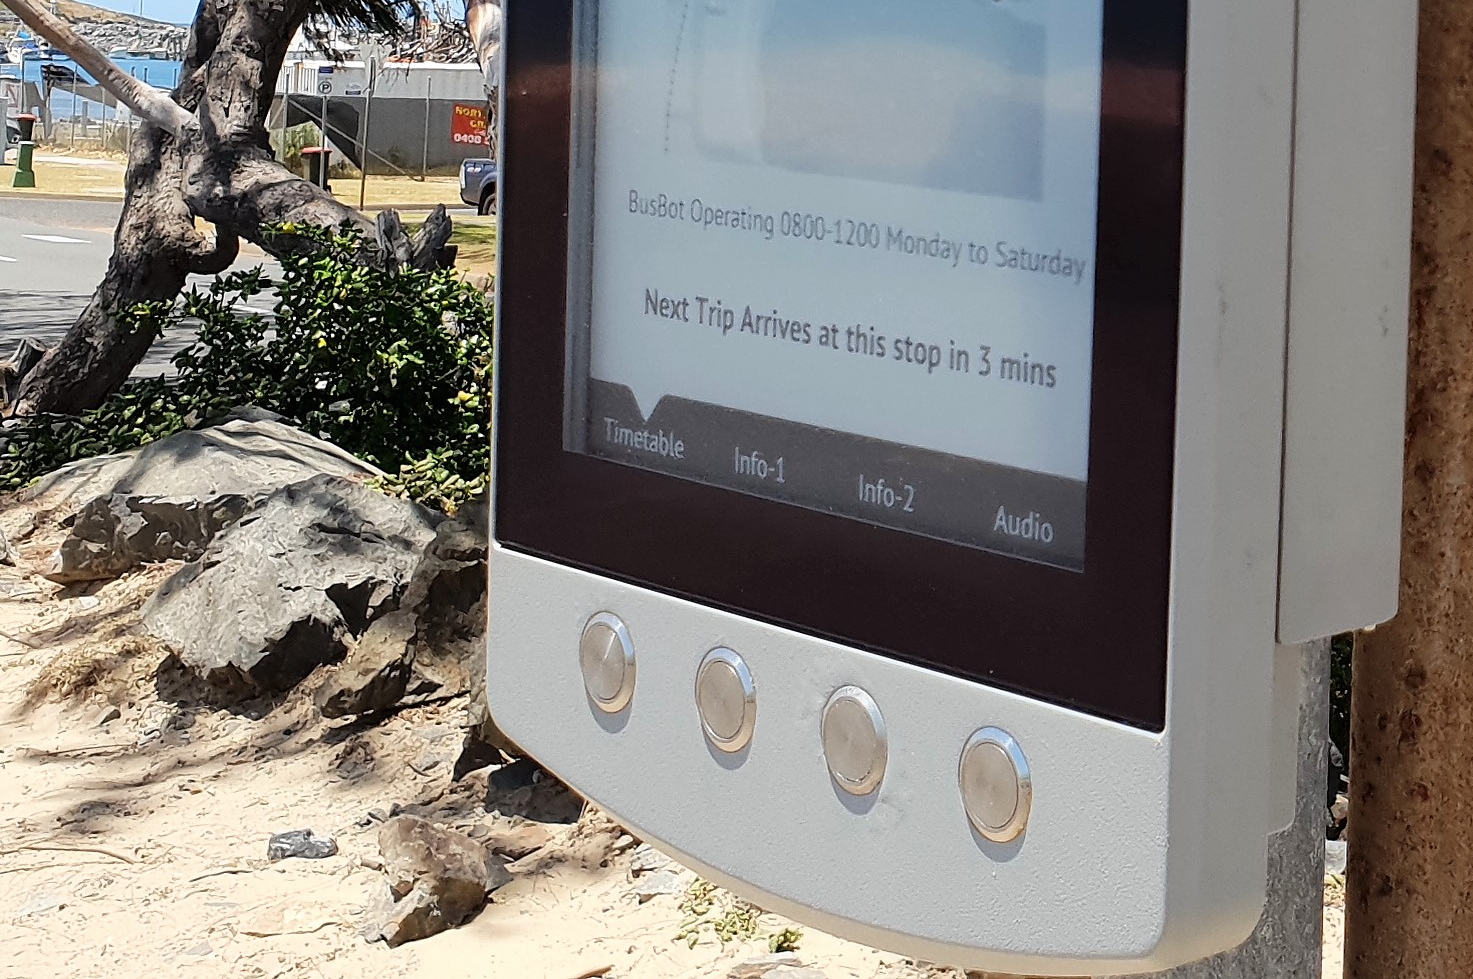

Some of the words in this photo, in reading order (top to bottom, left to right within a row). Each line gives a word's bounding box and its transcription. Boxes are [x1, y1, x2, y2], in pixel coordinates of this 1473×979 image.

[628, 189, 685, 221] BusBot
[690, 199, 775, 242] Operating
[780, 211, 880, 249] 0800-1200
[887, 226, 962, 267] Monday
[968, 240, 989, 266] to
[994, 242, 1086, 285] Saturday
[644, 288, 690, 322] Next
[694, 296, 734, 336] Trip
[740, 306, 811, 345] Arrives
[818, 324, 839, 351] at
[845, 325, 887, 359] this
[893, 336, 941, 374] stop
[948, 339, 970, 374] in
[977, 345, 992, 377] 3
[999, 352, 1058, 388] mins
[603, 418, 686, 461] Timetable
[733, 446, 786, 485] Info-1
[858, 475, 915, 513] Info-2
[993, 505, 1055, 543] Audio
